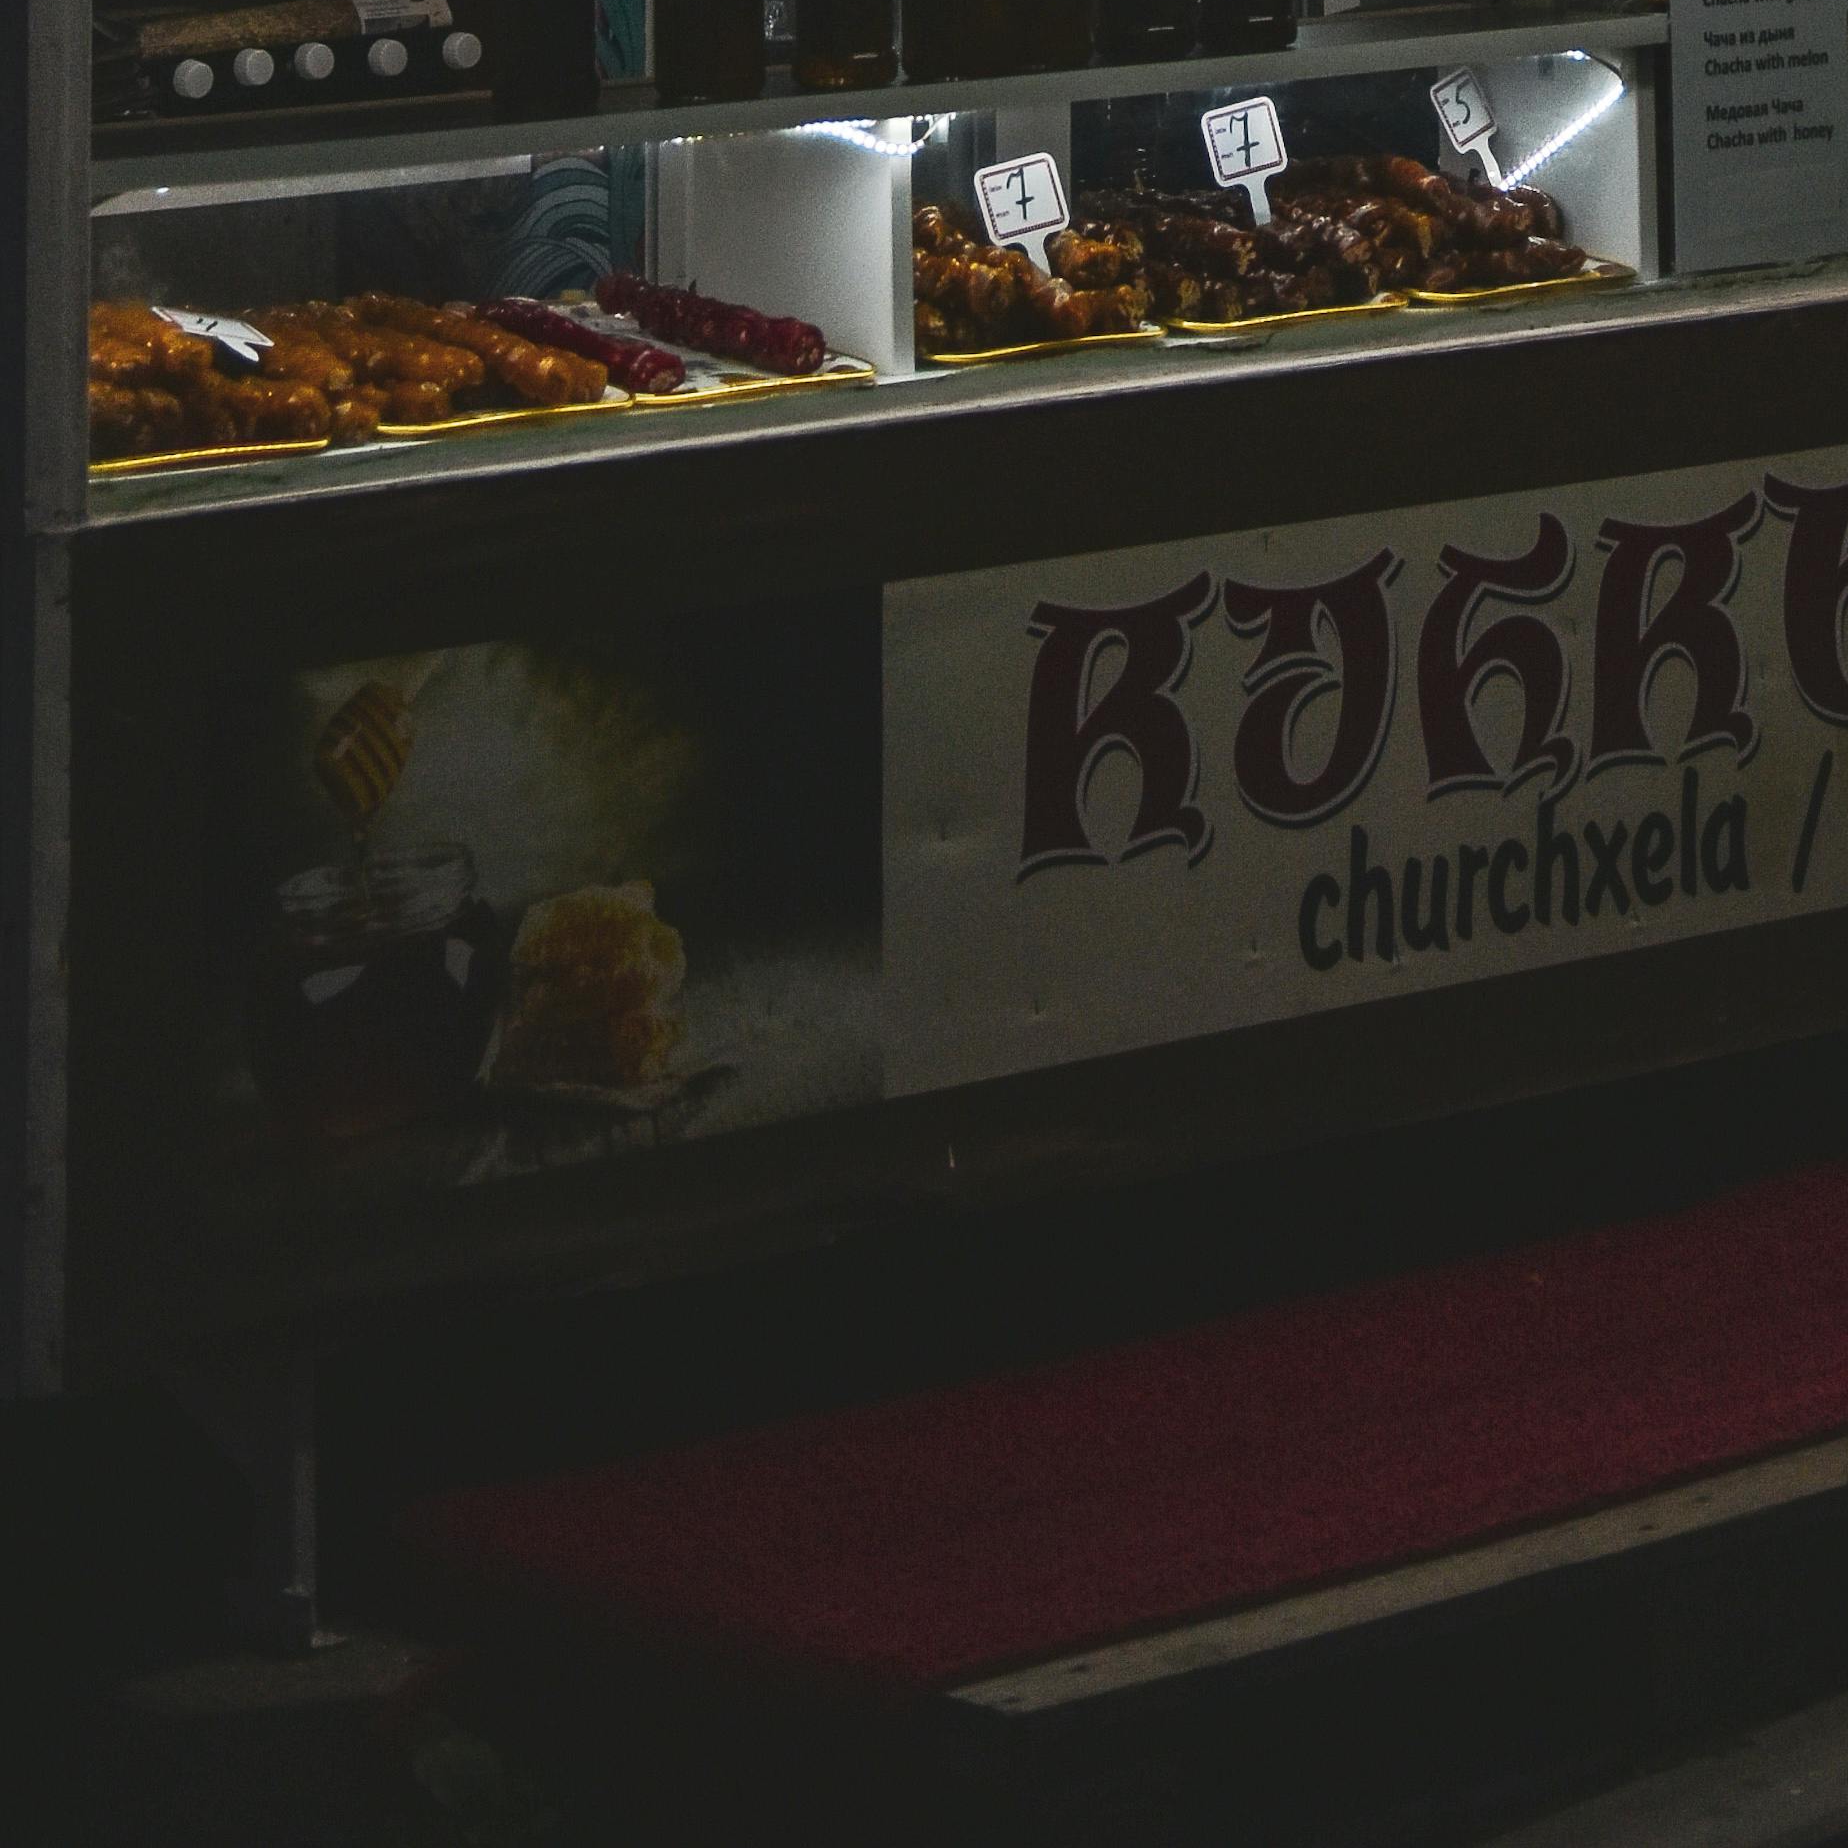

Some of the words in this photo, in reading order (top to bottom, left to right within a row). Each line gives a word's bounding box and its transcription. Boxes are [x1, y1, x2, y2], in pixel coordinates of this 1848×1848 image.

[1704, 29, 1736, 48] Чача
[1739, 29, 1756, 45] из
[1704, 58, 1752, 77] Chacha
[1755, 53, 1785, 73] with
[1788, 50, 1829, 69] melon
[1455, 78, 1472, 124] 5
[1706, 101, 1769, 122] Медовая
[1229, 111, 1260, 168] 7
[1706, 132, 1754, 151] Chacha
[1757, 126, 1788, 145] with
[1006, 166, 1035, 221] 7
[1301, 765, 1750, 971] churchxela
